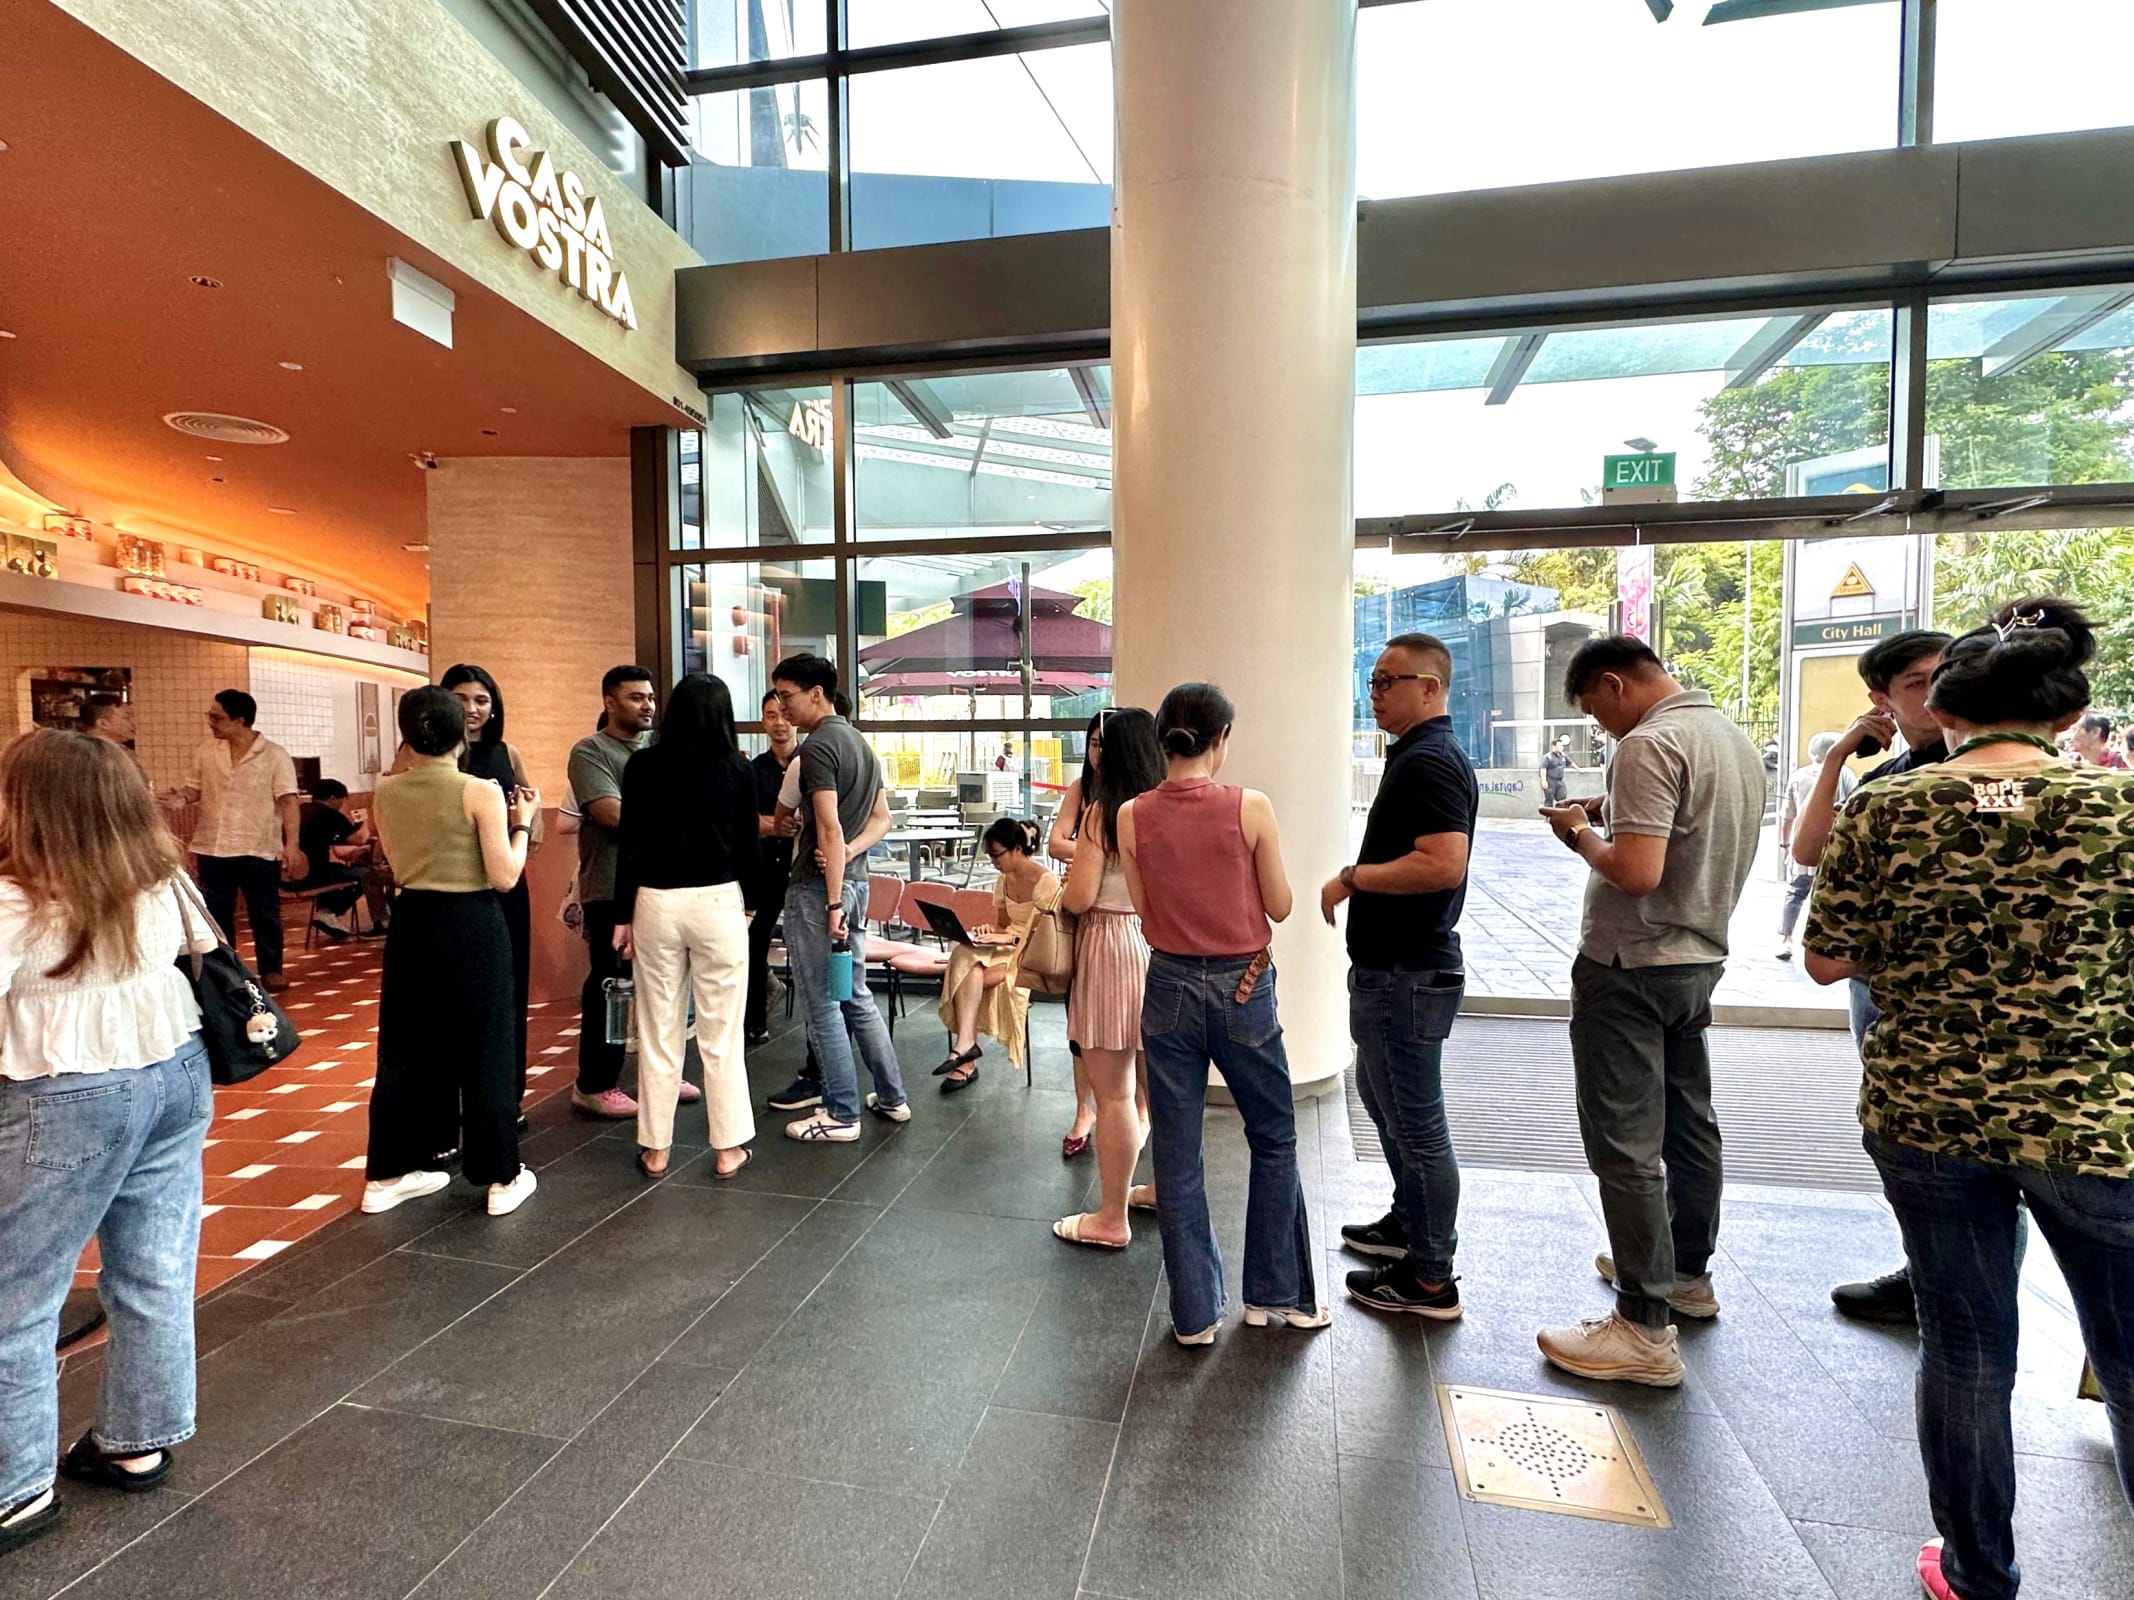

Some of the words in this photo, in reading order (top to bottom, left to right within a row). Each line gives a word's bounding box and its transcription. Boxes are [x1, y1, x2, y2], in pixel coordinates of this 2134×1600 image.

[487, 116, 614, 259] CASA
[449, 140, 638, 331] VOSTRA
[1616, 459, 1664, 483] EXIT
[1822, 627, 1848, 640] City
[1852, 623, 1882, 637] Hall
[1976, 795, 2024, 807] XXV
